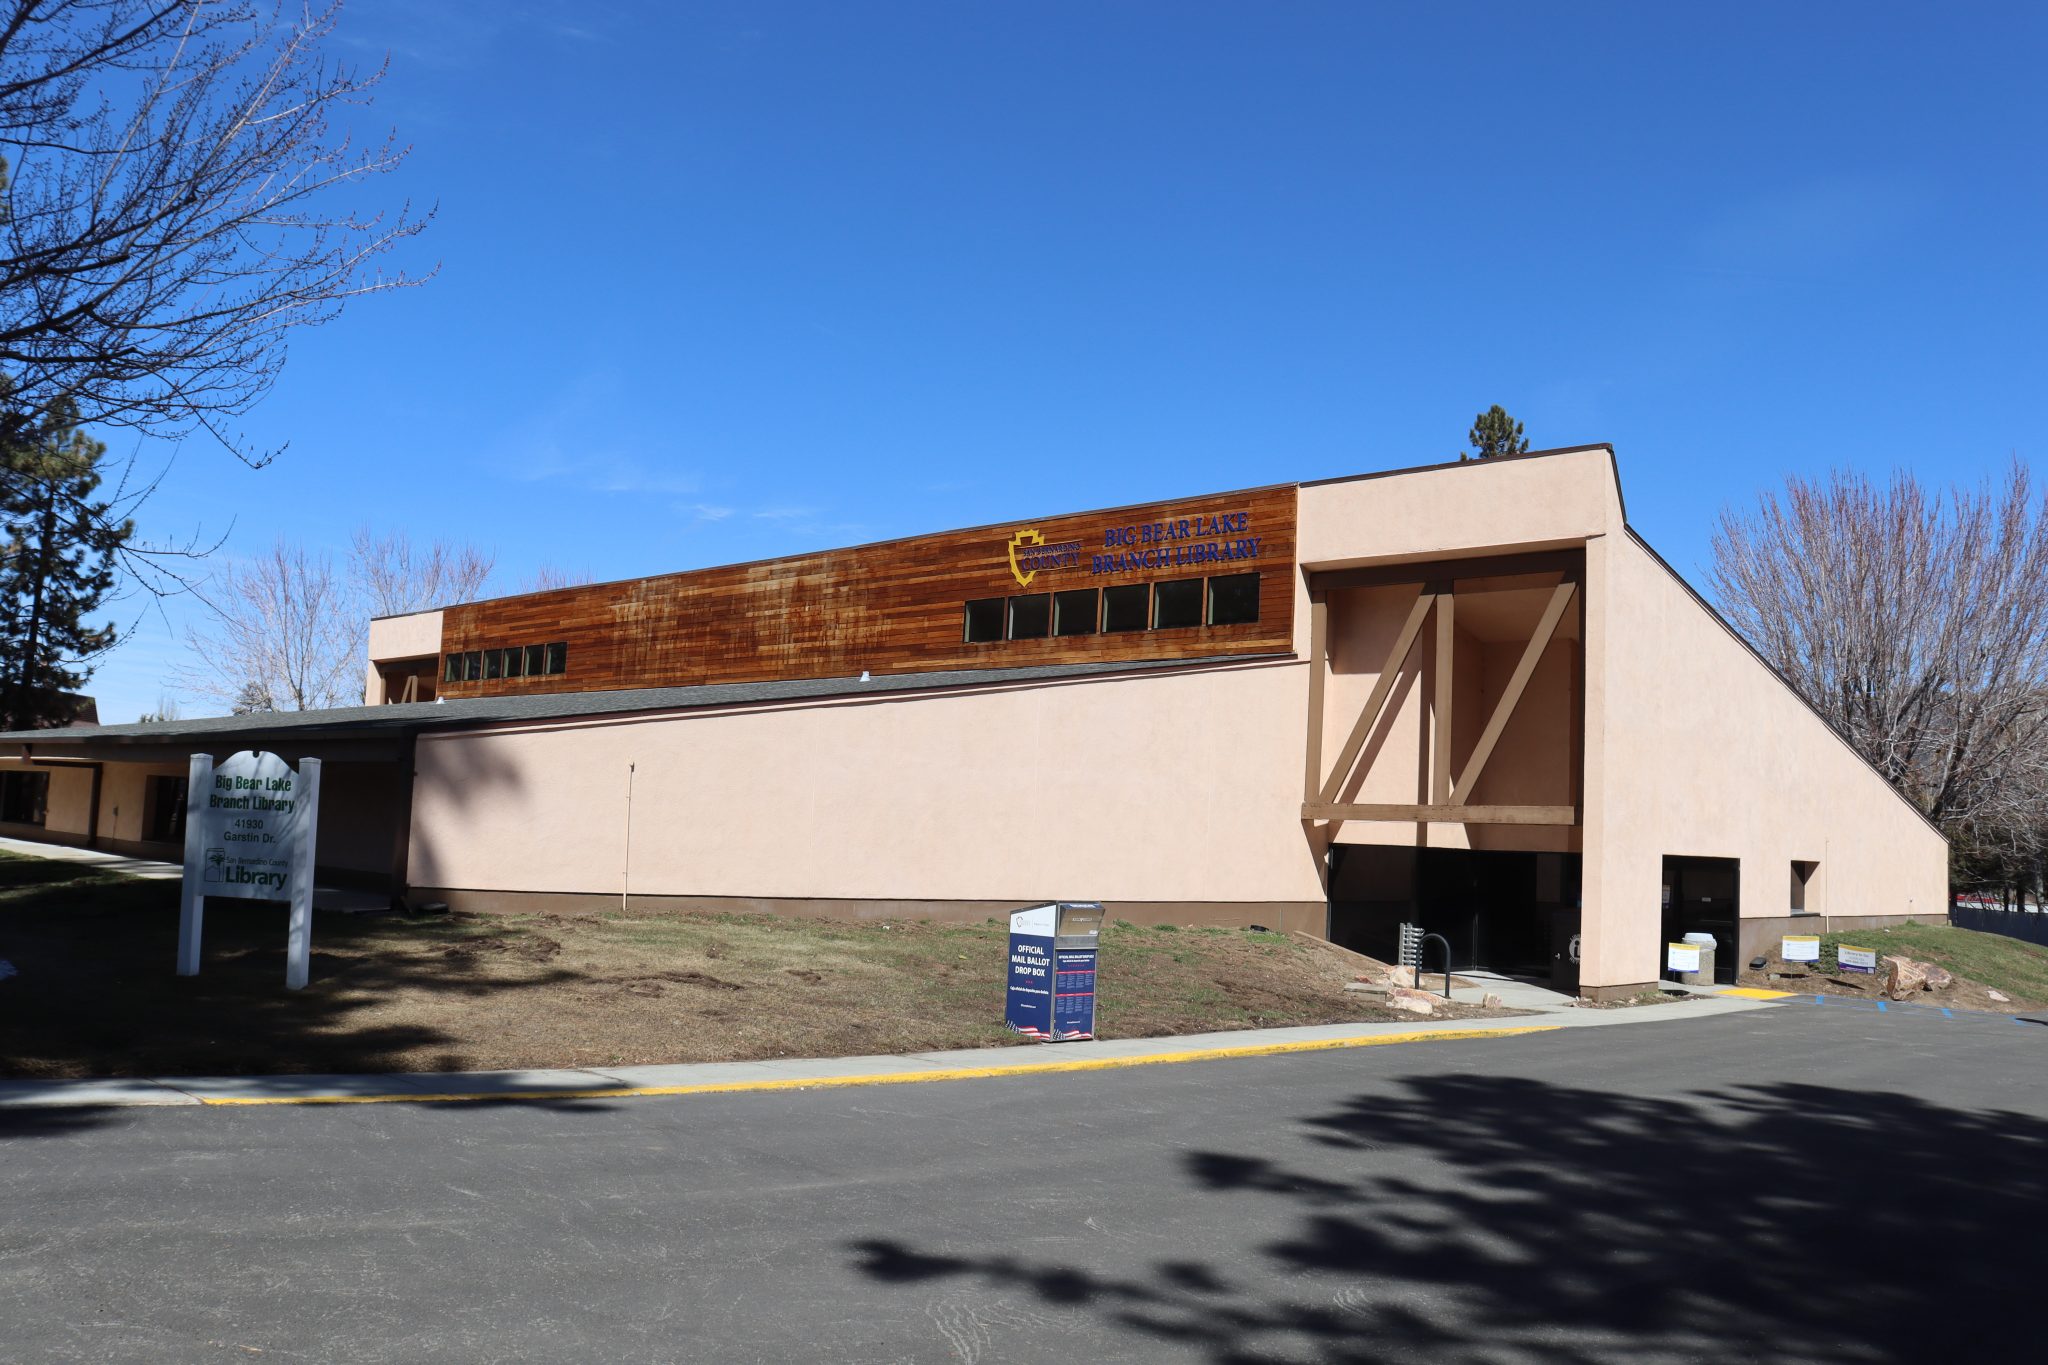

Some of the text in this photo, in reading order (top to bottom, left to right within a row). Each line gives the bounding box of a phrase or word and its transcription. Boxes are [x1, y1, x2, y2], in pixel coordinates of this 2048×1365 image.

[1105, 511, 1248, 546] BIG BEAR LAKE
[1021, 553, 1080, 571] COUNTY
[1092, 537, 1262, 574] BRANCH LIBRARY
[215, 775, 292, 791] Big Bear Lake
[210, 794, 295, 814] Branch Library
[234, 819, 264, 829] 41930
[223, 831, 276, 843] Garstin Dr.
[225, 865, 288, 891] Library
[1017, 945, 1044, 955] OFFICIAL
[1011, 955, 1026, 964] MAIL
[1027, 957, 1050, 967] BALLOT
[1015, 966, 1046, 977] DROP BOX
